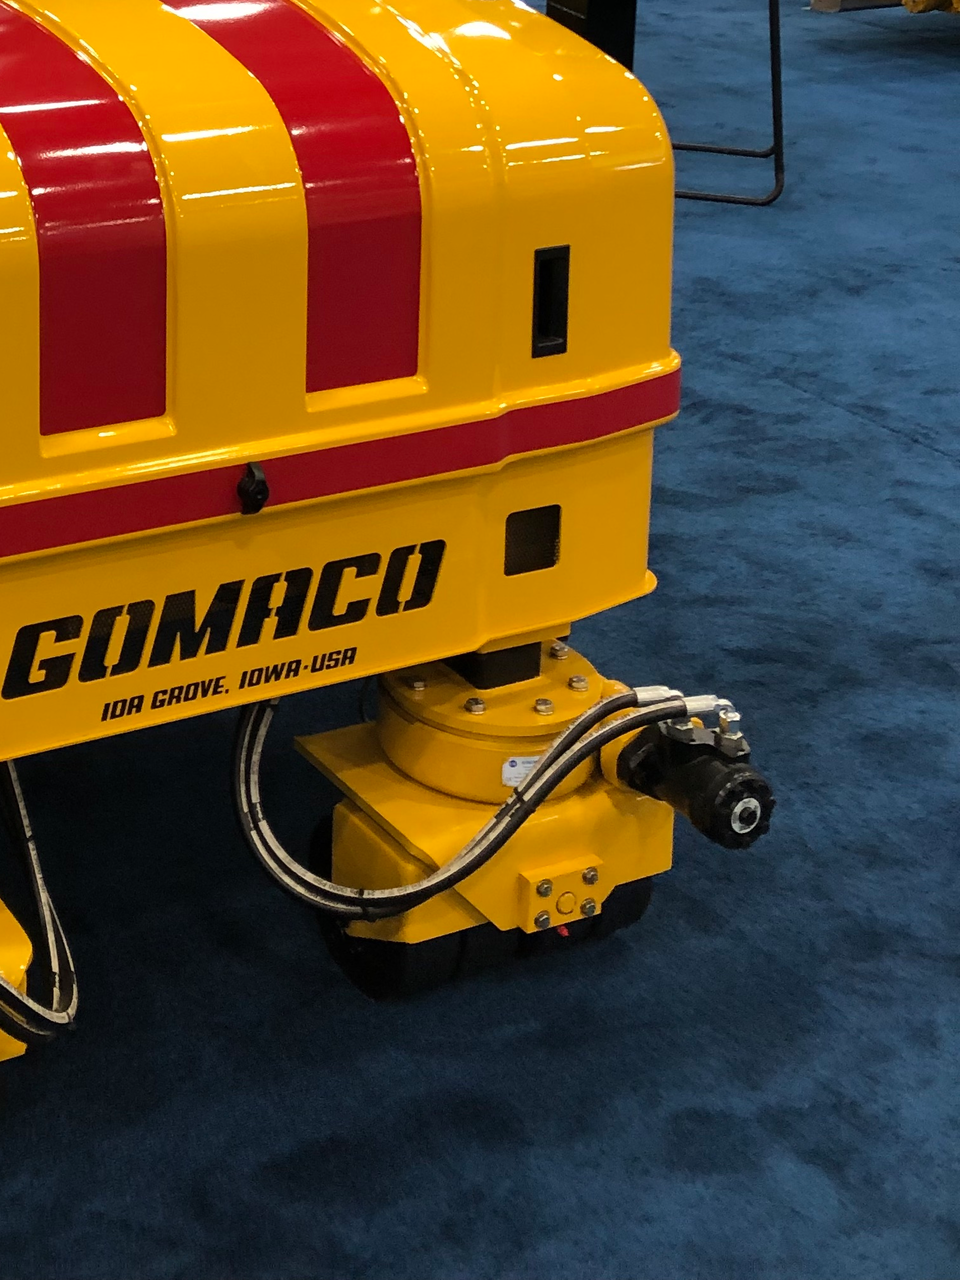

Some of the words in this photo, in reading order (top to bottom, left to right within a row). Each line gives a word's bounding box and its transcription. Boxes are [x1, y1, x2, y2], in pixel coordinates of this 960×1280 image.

[1, 539, 448, 700] GOMACO
[101, 695, 145, 722] IDA
[151, 677, 230, 710] GROVE,
